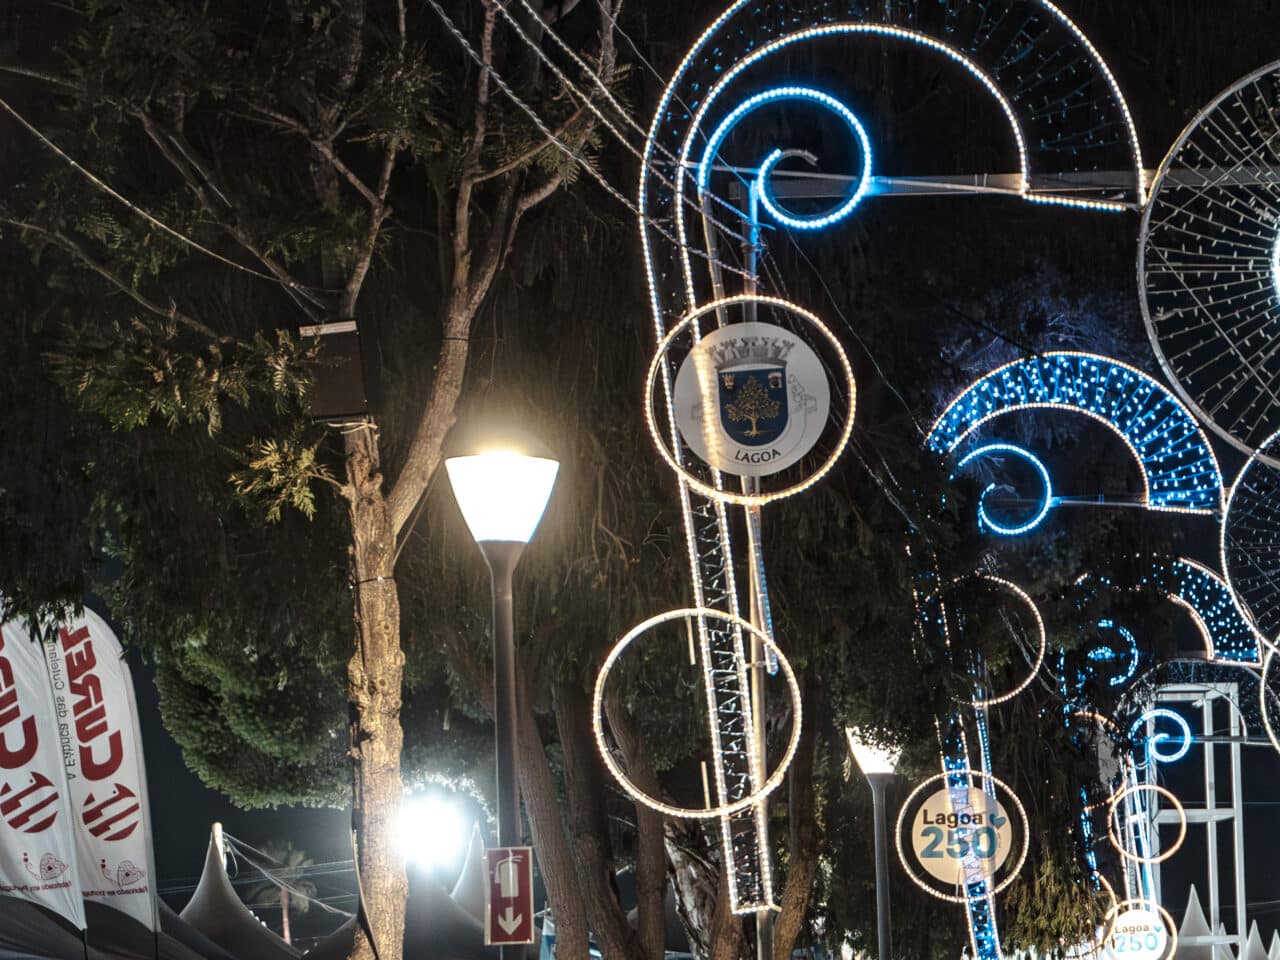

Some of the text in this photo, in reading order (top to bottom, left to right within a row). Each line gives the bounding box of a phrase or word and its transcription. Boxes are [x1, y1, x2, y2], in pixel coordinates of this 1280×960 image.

[735, 449, 781, 464] LAGOA
[923, 809, 983, 828] Lagoa
[920, 826, 997, 858] 250
[1115, 925, 1149, 934] Lagoa
[1115, 932, 1158, 952] 250
